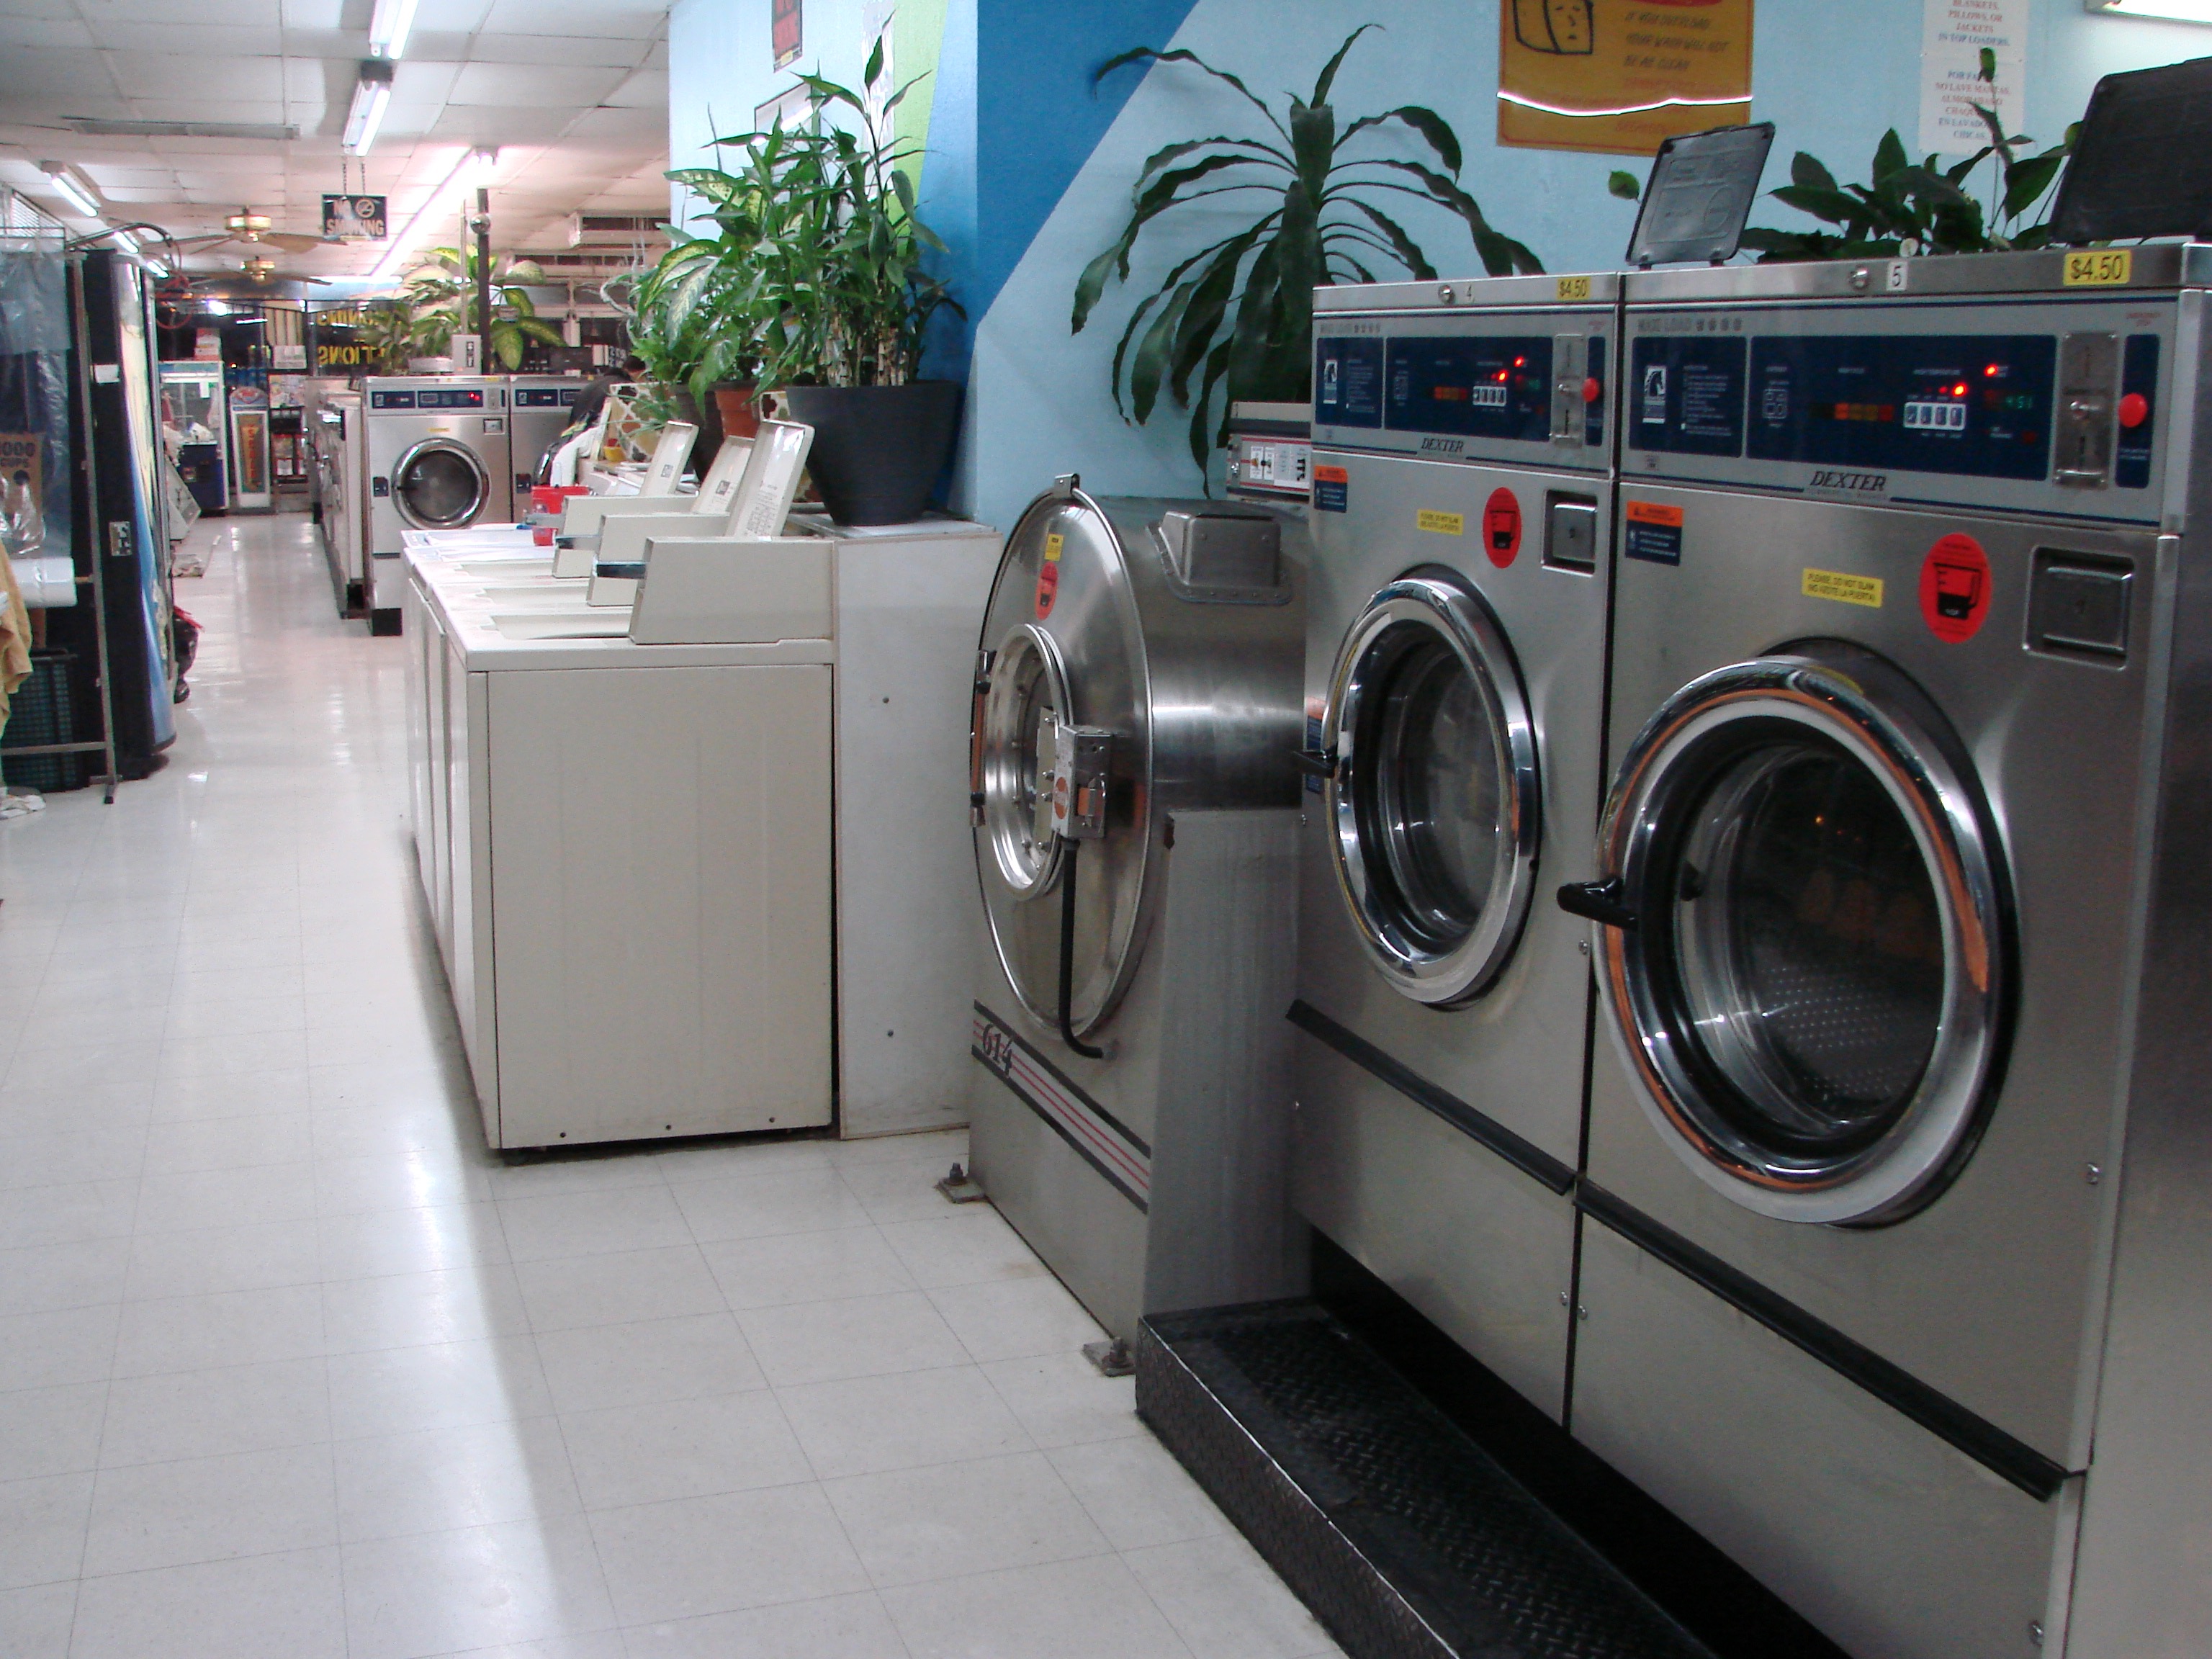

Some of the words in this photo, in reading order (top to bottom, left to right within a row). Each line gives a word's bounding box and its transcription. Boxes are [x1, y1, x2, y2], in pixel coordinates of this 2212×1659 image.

[1892, 266, 1901, 287] 5
[2071, 254, 2123, 280] $4.50
[1421, 437, 1465, 453] DEXTER
[1809, 470, 1887, 492] DEXTER
